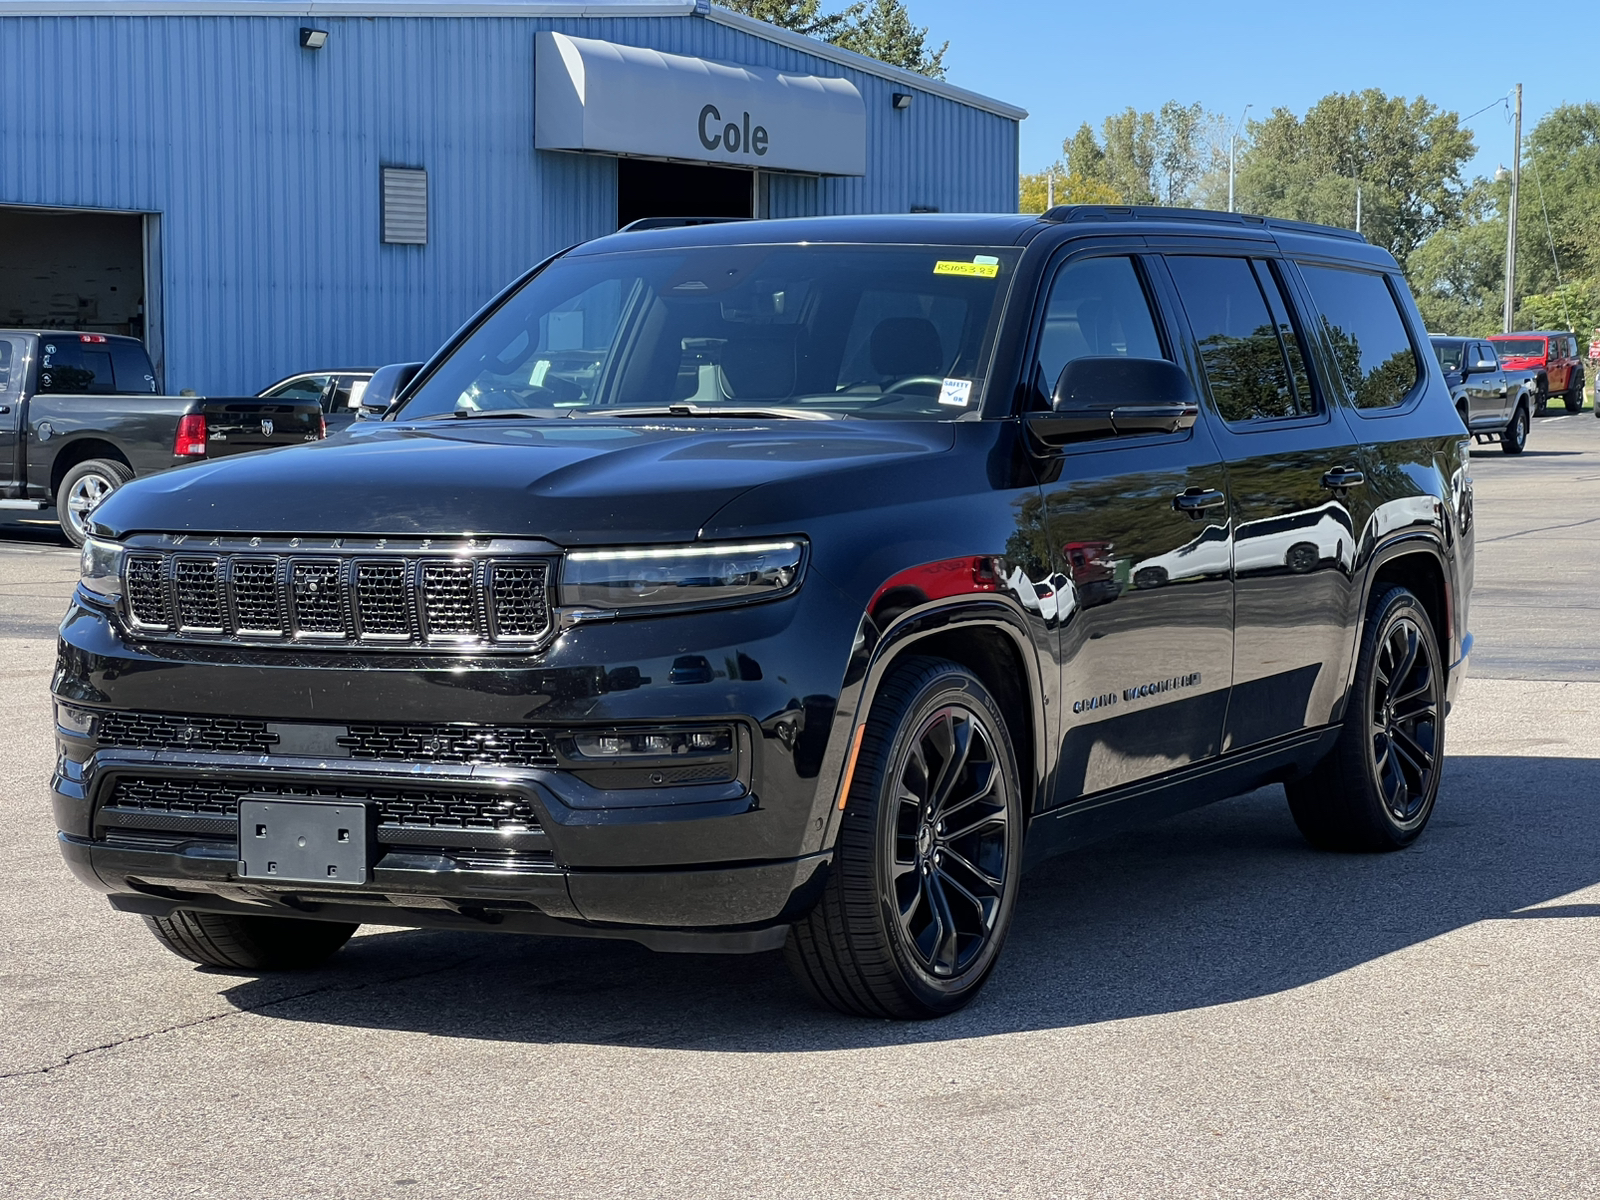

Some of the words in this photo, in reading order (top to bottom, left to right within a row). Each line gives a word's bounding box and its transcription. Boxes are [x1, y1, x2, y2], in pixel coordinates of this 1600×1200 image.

[698, 104, 769, 156] Cole
[944, 380, 969, 388] SAFETY
[1073, 692, 1118, 714] GRAND
[1123, 672, 1202, 702] WAGONEER
